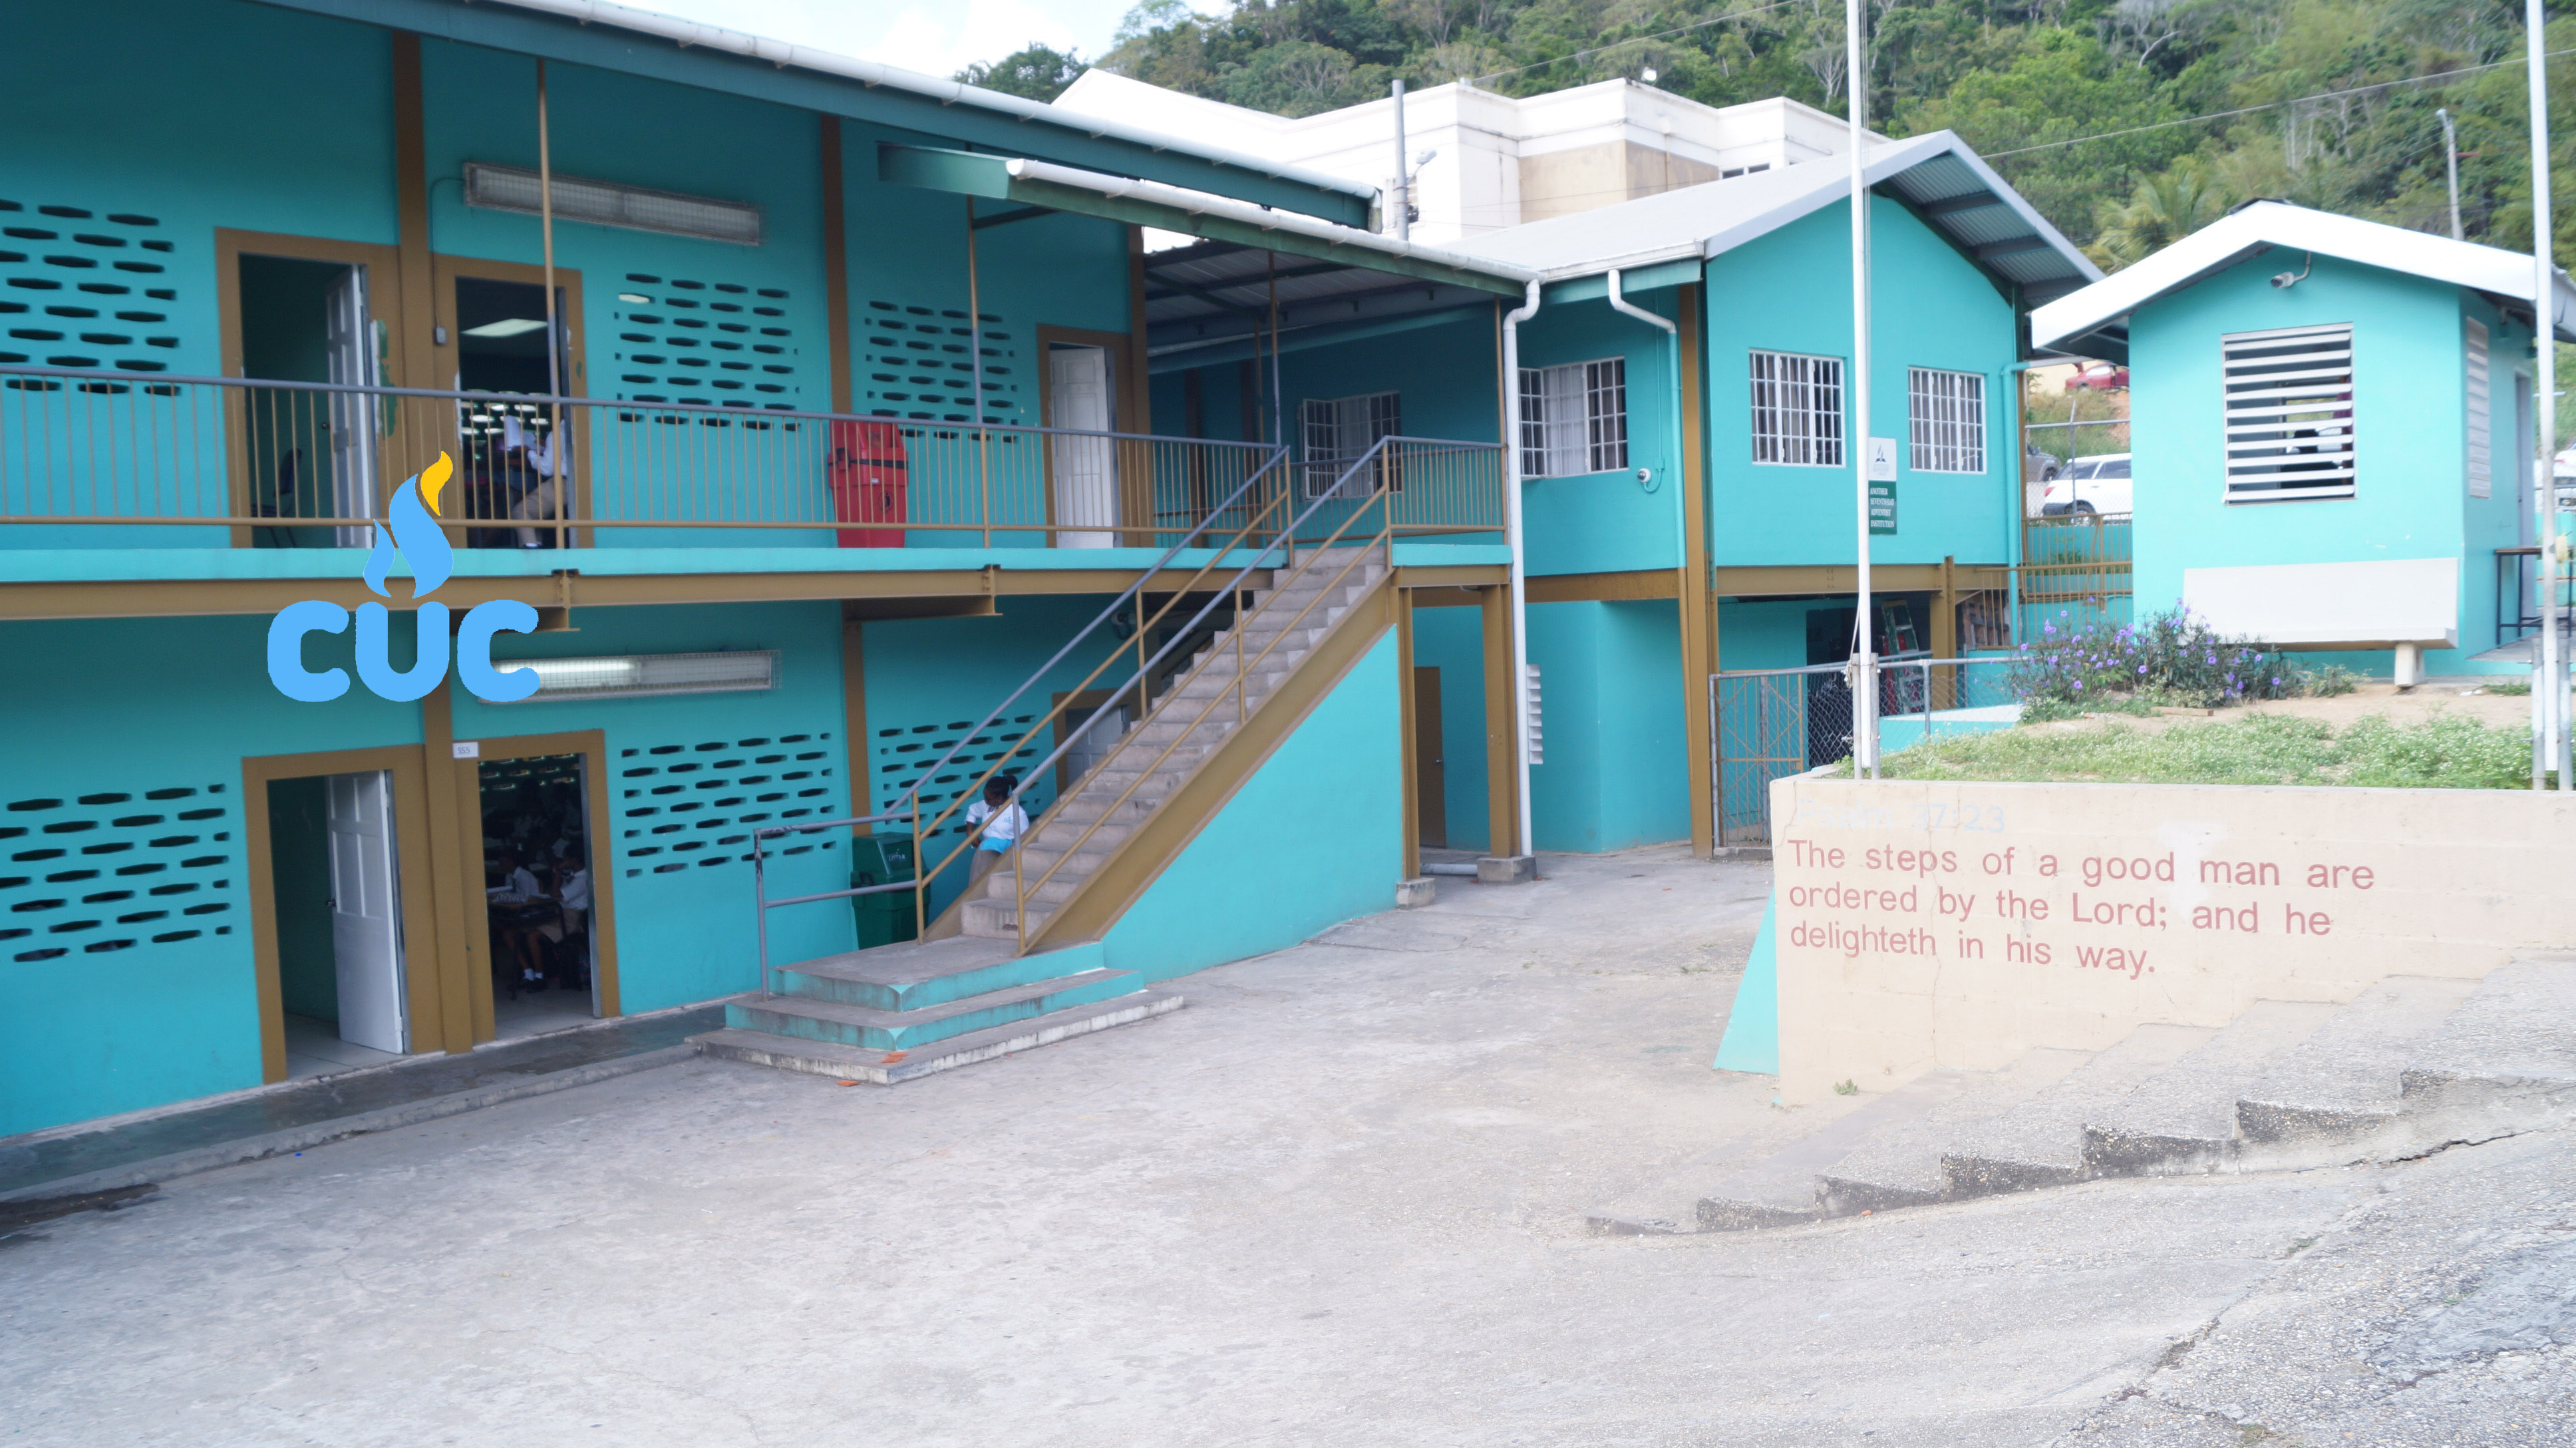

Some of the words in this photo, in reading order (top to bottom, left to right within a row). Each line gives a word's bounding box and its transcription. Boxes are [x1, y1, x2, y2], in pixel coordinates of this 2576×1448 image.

[1798, 799, 1891, 828] Psalm
[1910, 803, 2005, 832] 37:23
[1788, 839, 1846, 869] The
[1865, 846, 1957, 878] steps
[1982, 846, 2015, 876] of
[2038, 854, 2058, 878] a
[2082, 852, 2175, 888] good
[2199, 861, 2280, 886] man
[2307, 864, 2374, 890] are
[1789, 882, 1917, 913] ordered
[1939, 886, 1975, 923] by
[1996, 889, 2048, 921] the
[2072, 892, 2168, 932] Lord;
[2192, 902, 2258, 933] and
[2285, 903, 2331, 936] he
[1790, 921, 1937, 958] delighteth
[1958, 932, 1983, 960] in
[2007, 934, 2052, 966] his
[2076, 947, 2156, 981] way.
